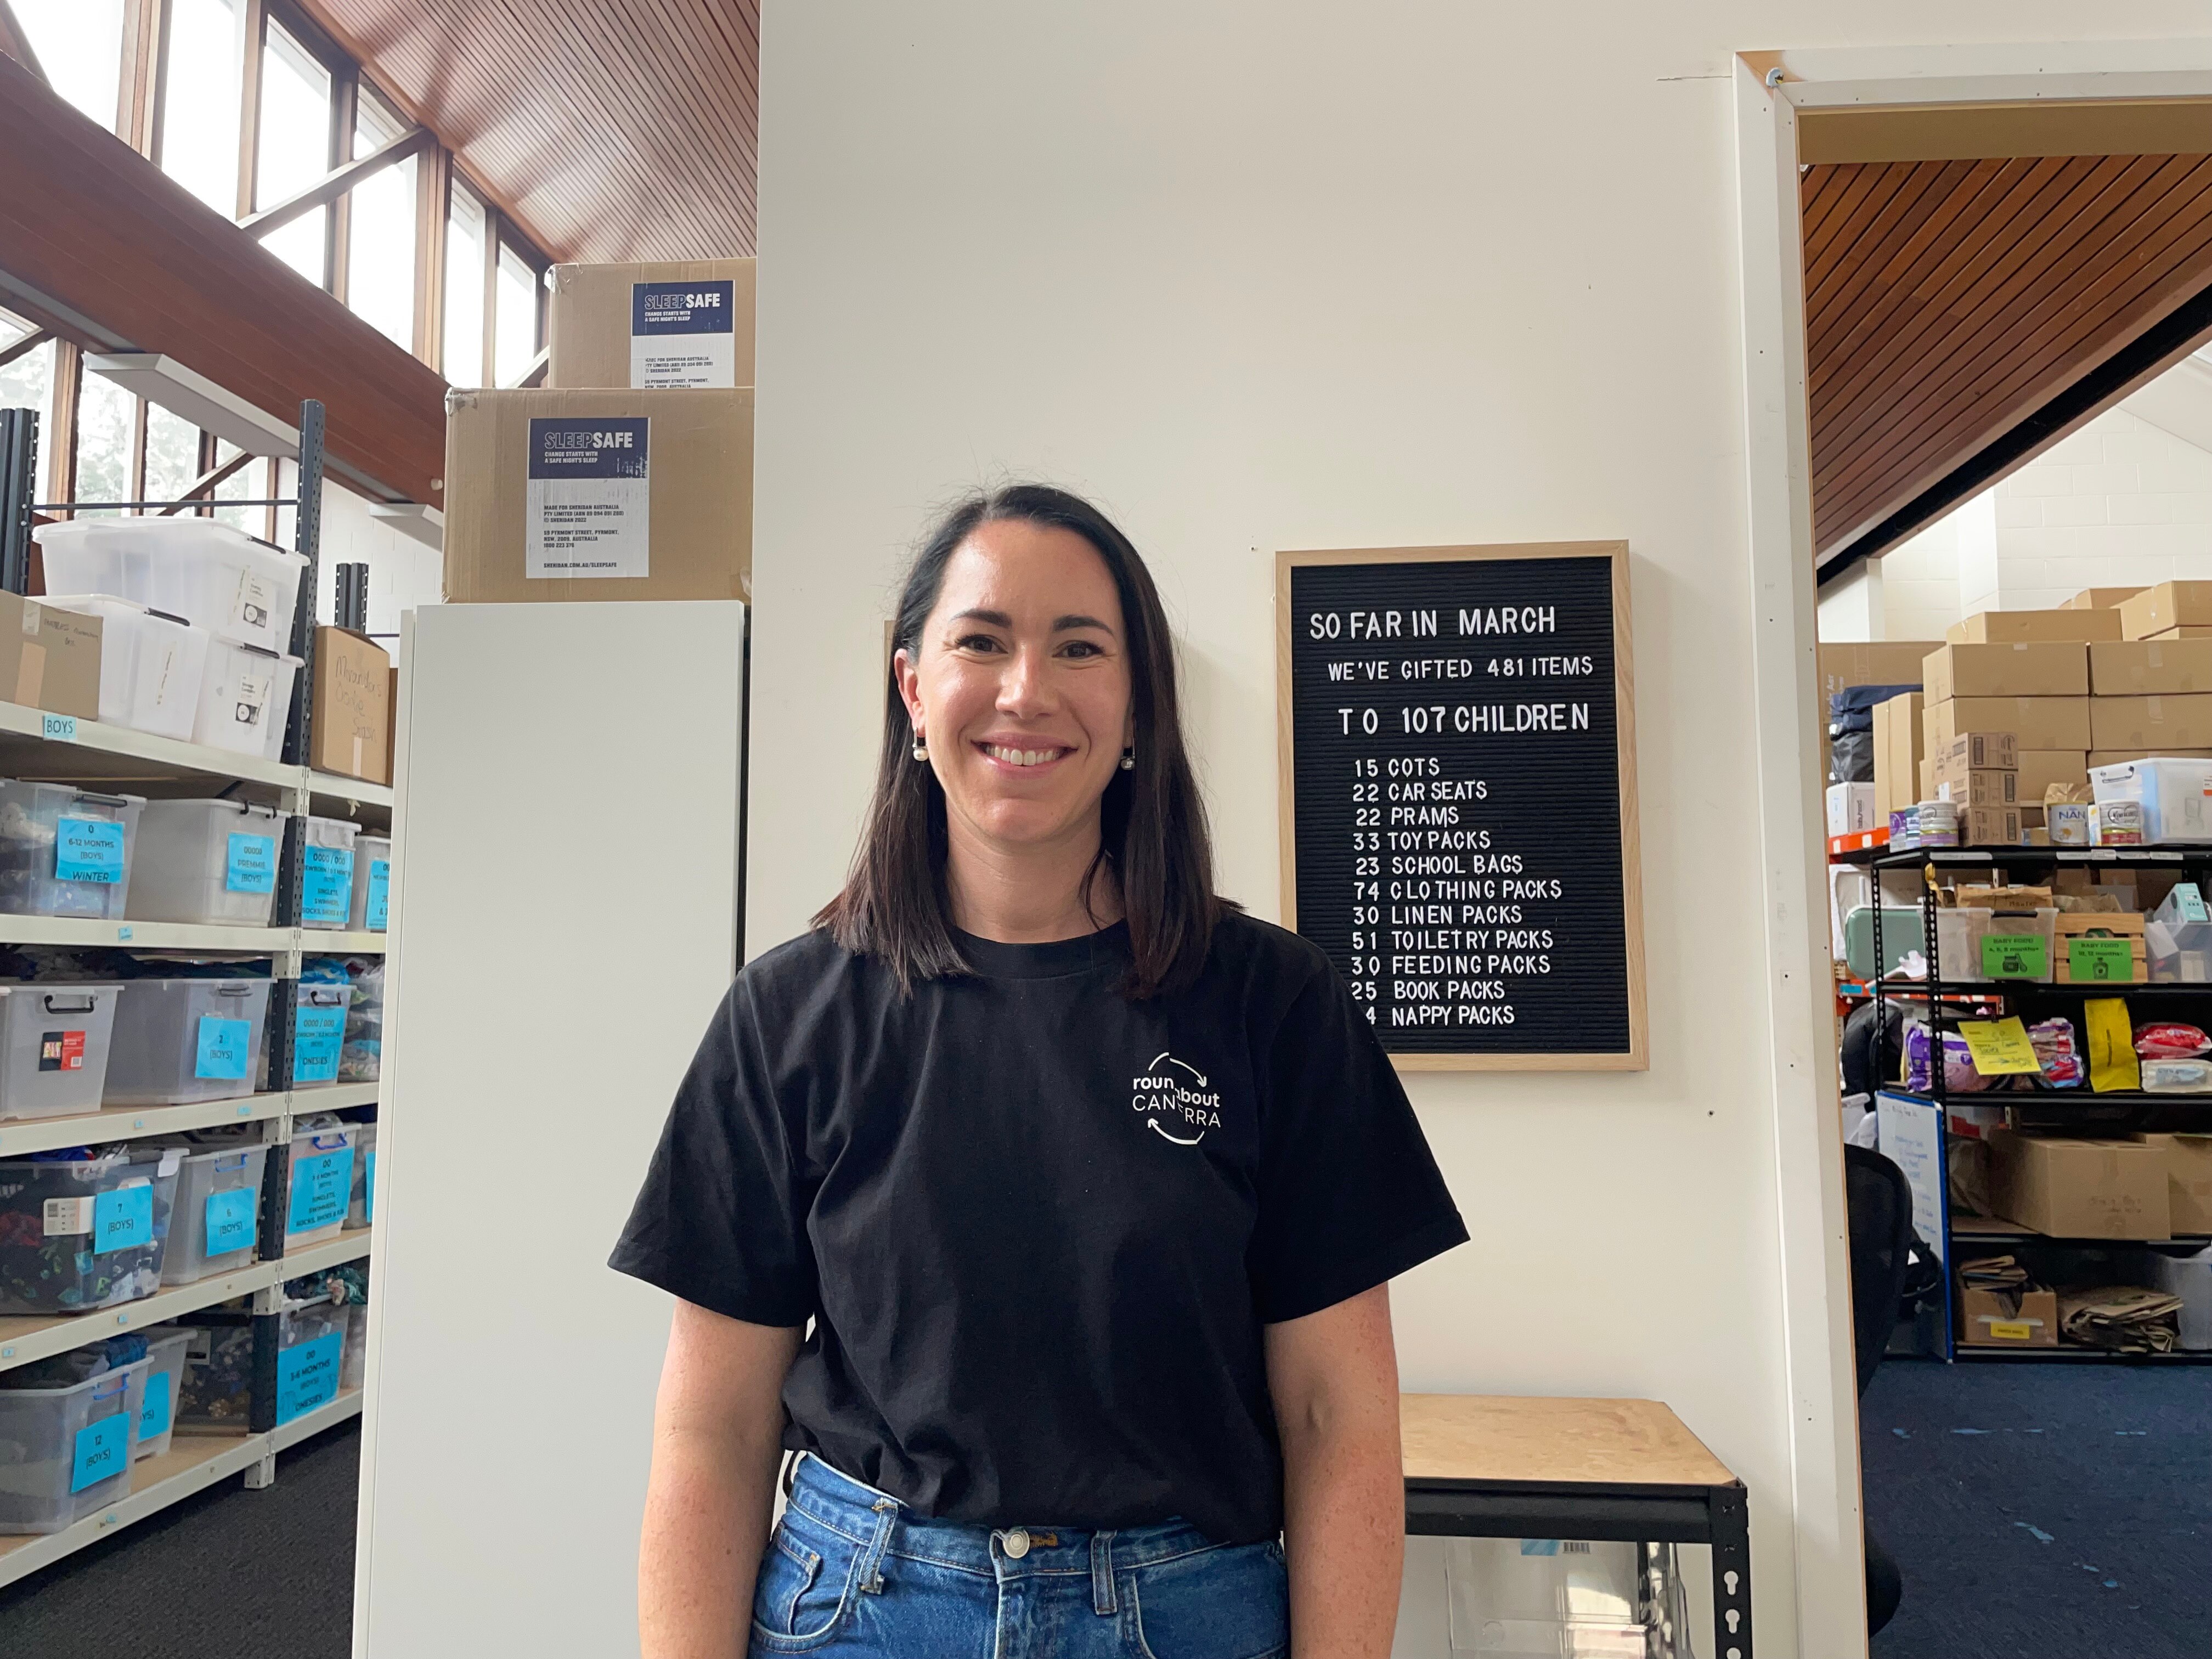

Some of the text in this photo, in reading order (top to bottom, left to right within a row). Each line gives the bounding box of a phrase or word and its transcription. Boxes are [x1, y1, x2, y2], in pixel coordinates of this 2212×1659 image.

[645, 293, 720, 309] SLEEPSAFE
[544, 432, 633, 449] SLEEPSAFE
[1310, 606, 1555, 640] SO FAR IN MARCH
[1328, 656, 1593, 681] WE'VE GIFTED 481 ITEMS
[47, 720, 72, 733] BOYS
[1338, 703, 1588, 735] TO 107 CHILDREN
[1355, 757, 1440, 778] 15 COTS
[1353, 779, 1487, 803] 22 CAR SEATS
[1356, 805, 1459, 828] 22 PRAMS
[84, 839, 114, 848] MONTHS
[1353, 830, 1491, 851] 33 TOY PACKS
[1356, 854, 1523, 876] 23 SCHOOL BAGS
[72, 871, 109, 882] WINTER
[1353, 879, 1562, 901] 74 CLOTHING PACKS
[1353, 905, 1522, 925] 30 LINEN PACKS
[1352, 929, 1553, 951] 51 TOILETRY PACKS
[1351, 955, 1550, 976] 30 FEEDING PACKS
[1351, 980, 1505, 1001] 25 BOOK PACKS
[1392, 1004, 1452, 1026] NAPPY
[1458, 1005, 1515, 1025] PACKS
[117, 1203, 122, 1213] 7
[108, 1218, 134, 1234] (BOYS)
